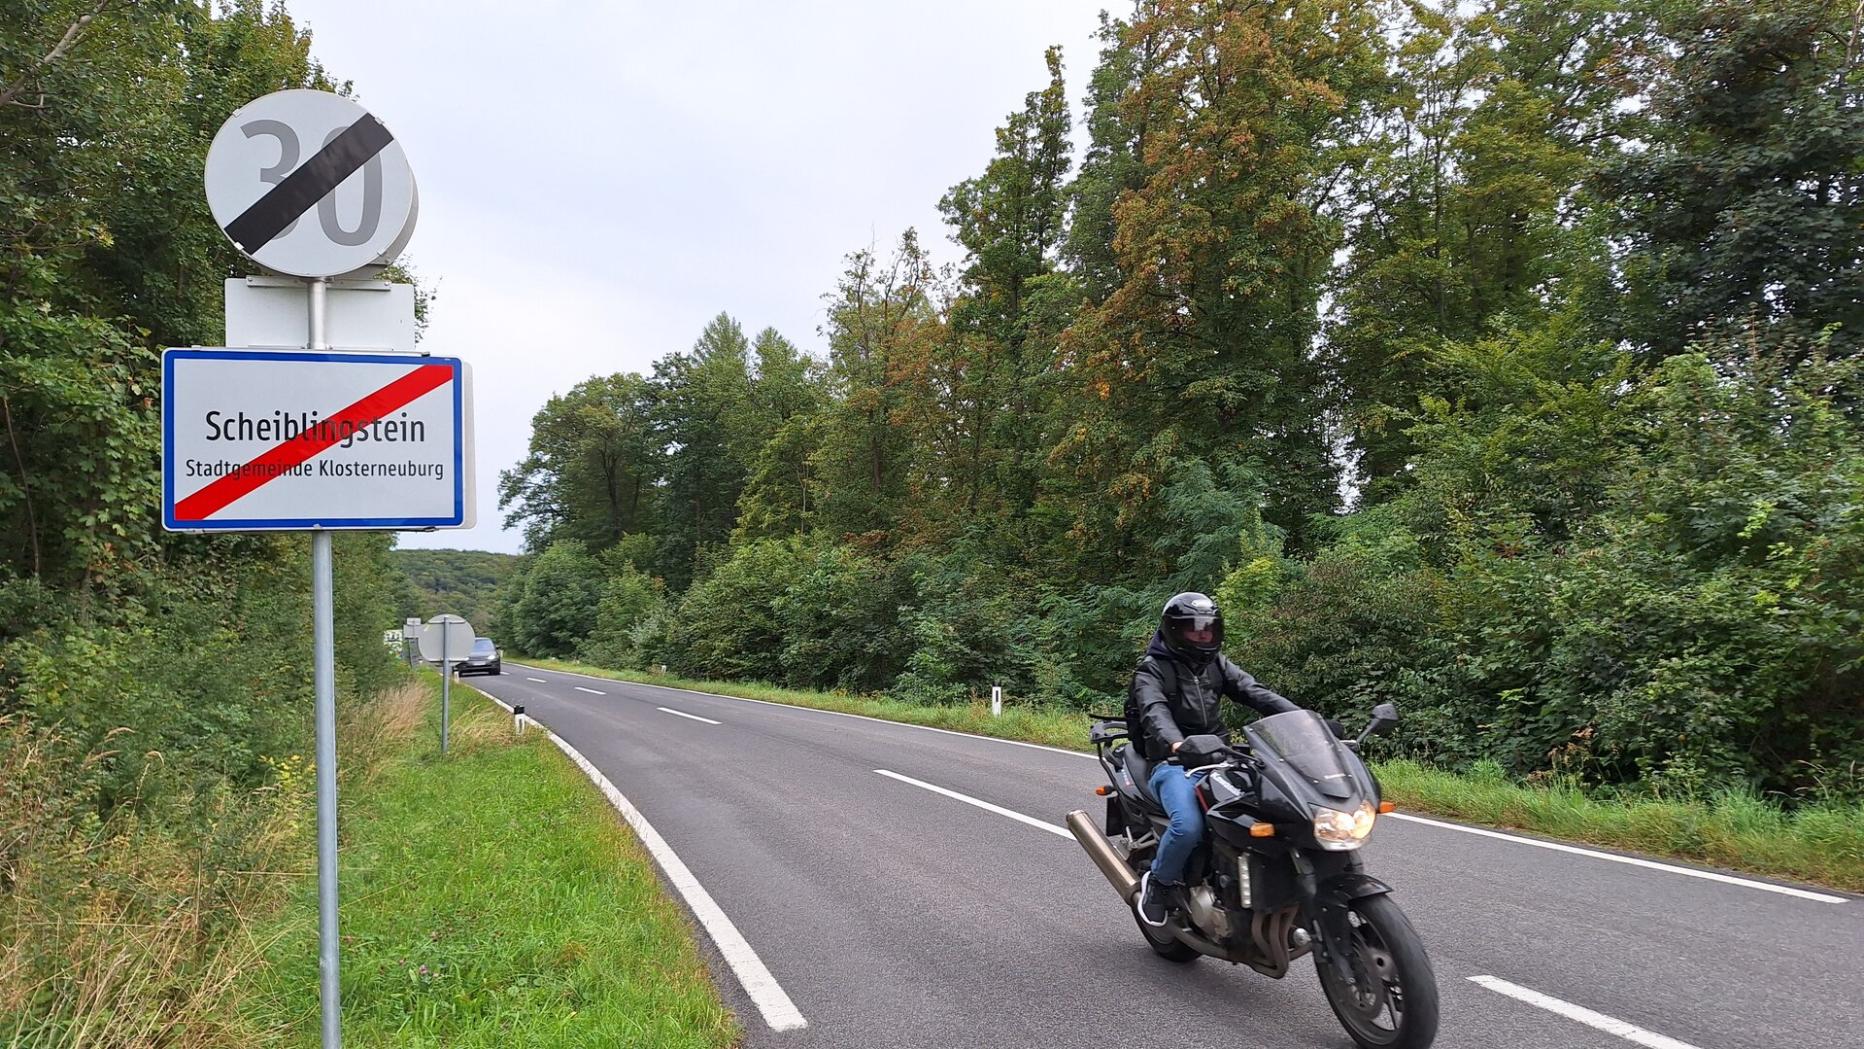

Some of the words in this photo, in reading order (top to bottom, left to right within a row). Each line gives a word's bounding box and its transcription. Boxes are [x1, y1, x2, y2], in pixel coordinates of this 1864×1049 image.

[240, 119, 383, 247] 30
[205, 410, 425, 448] Scheiblingstein
[186, 458, 312, 481] Stadtgemeinde
[319, 459, 444, 481] Klosterneuburg
